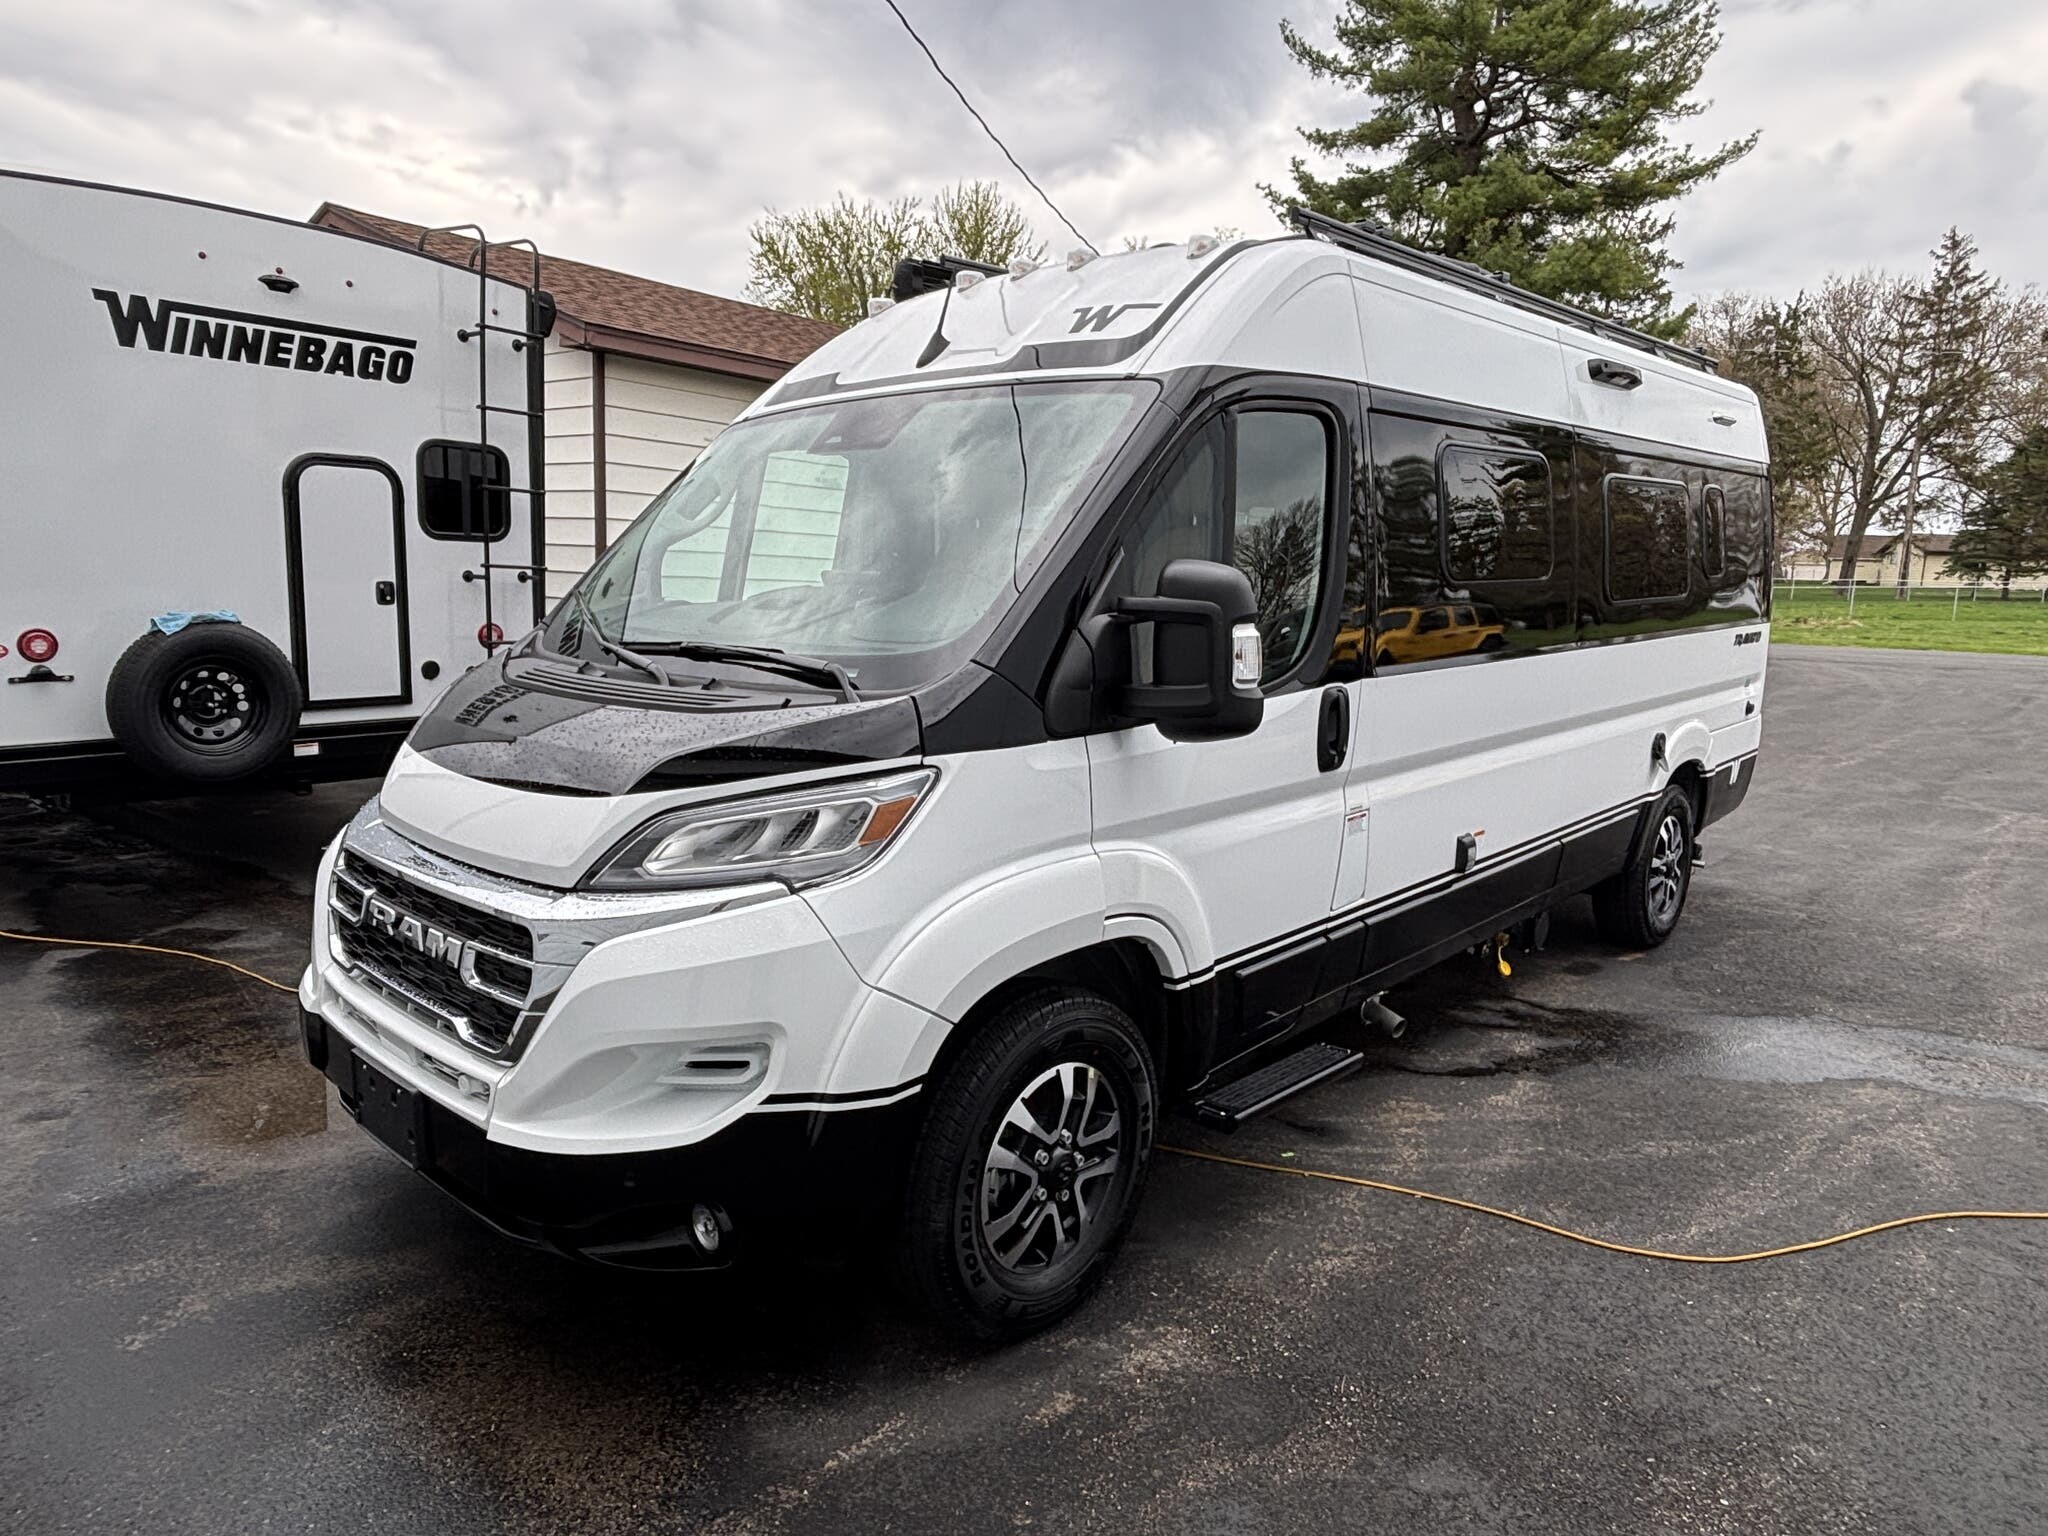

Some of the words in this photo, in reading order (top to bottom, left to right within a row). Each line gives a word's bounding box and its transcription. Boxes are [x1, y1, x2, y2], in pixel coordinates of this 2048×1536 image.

[91, 288, 417, 384] WINNEBAGO
[1068, 303, 1163, 334] W
[369, 899, 464, 969] RAM
